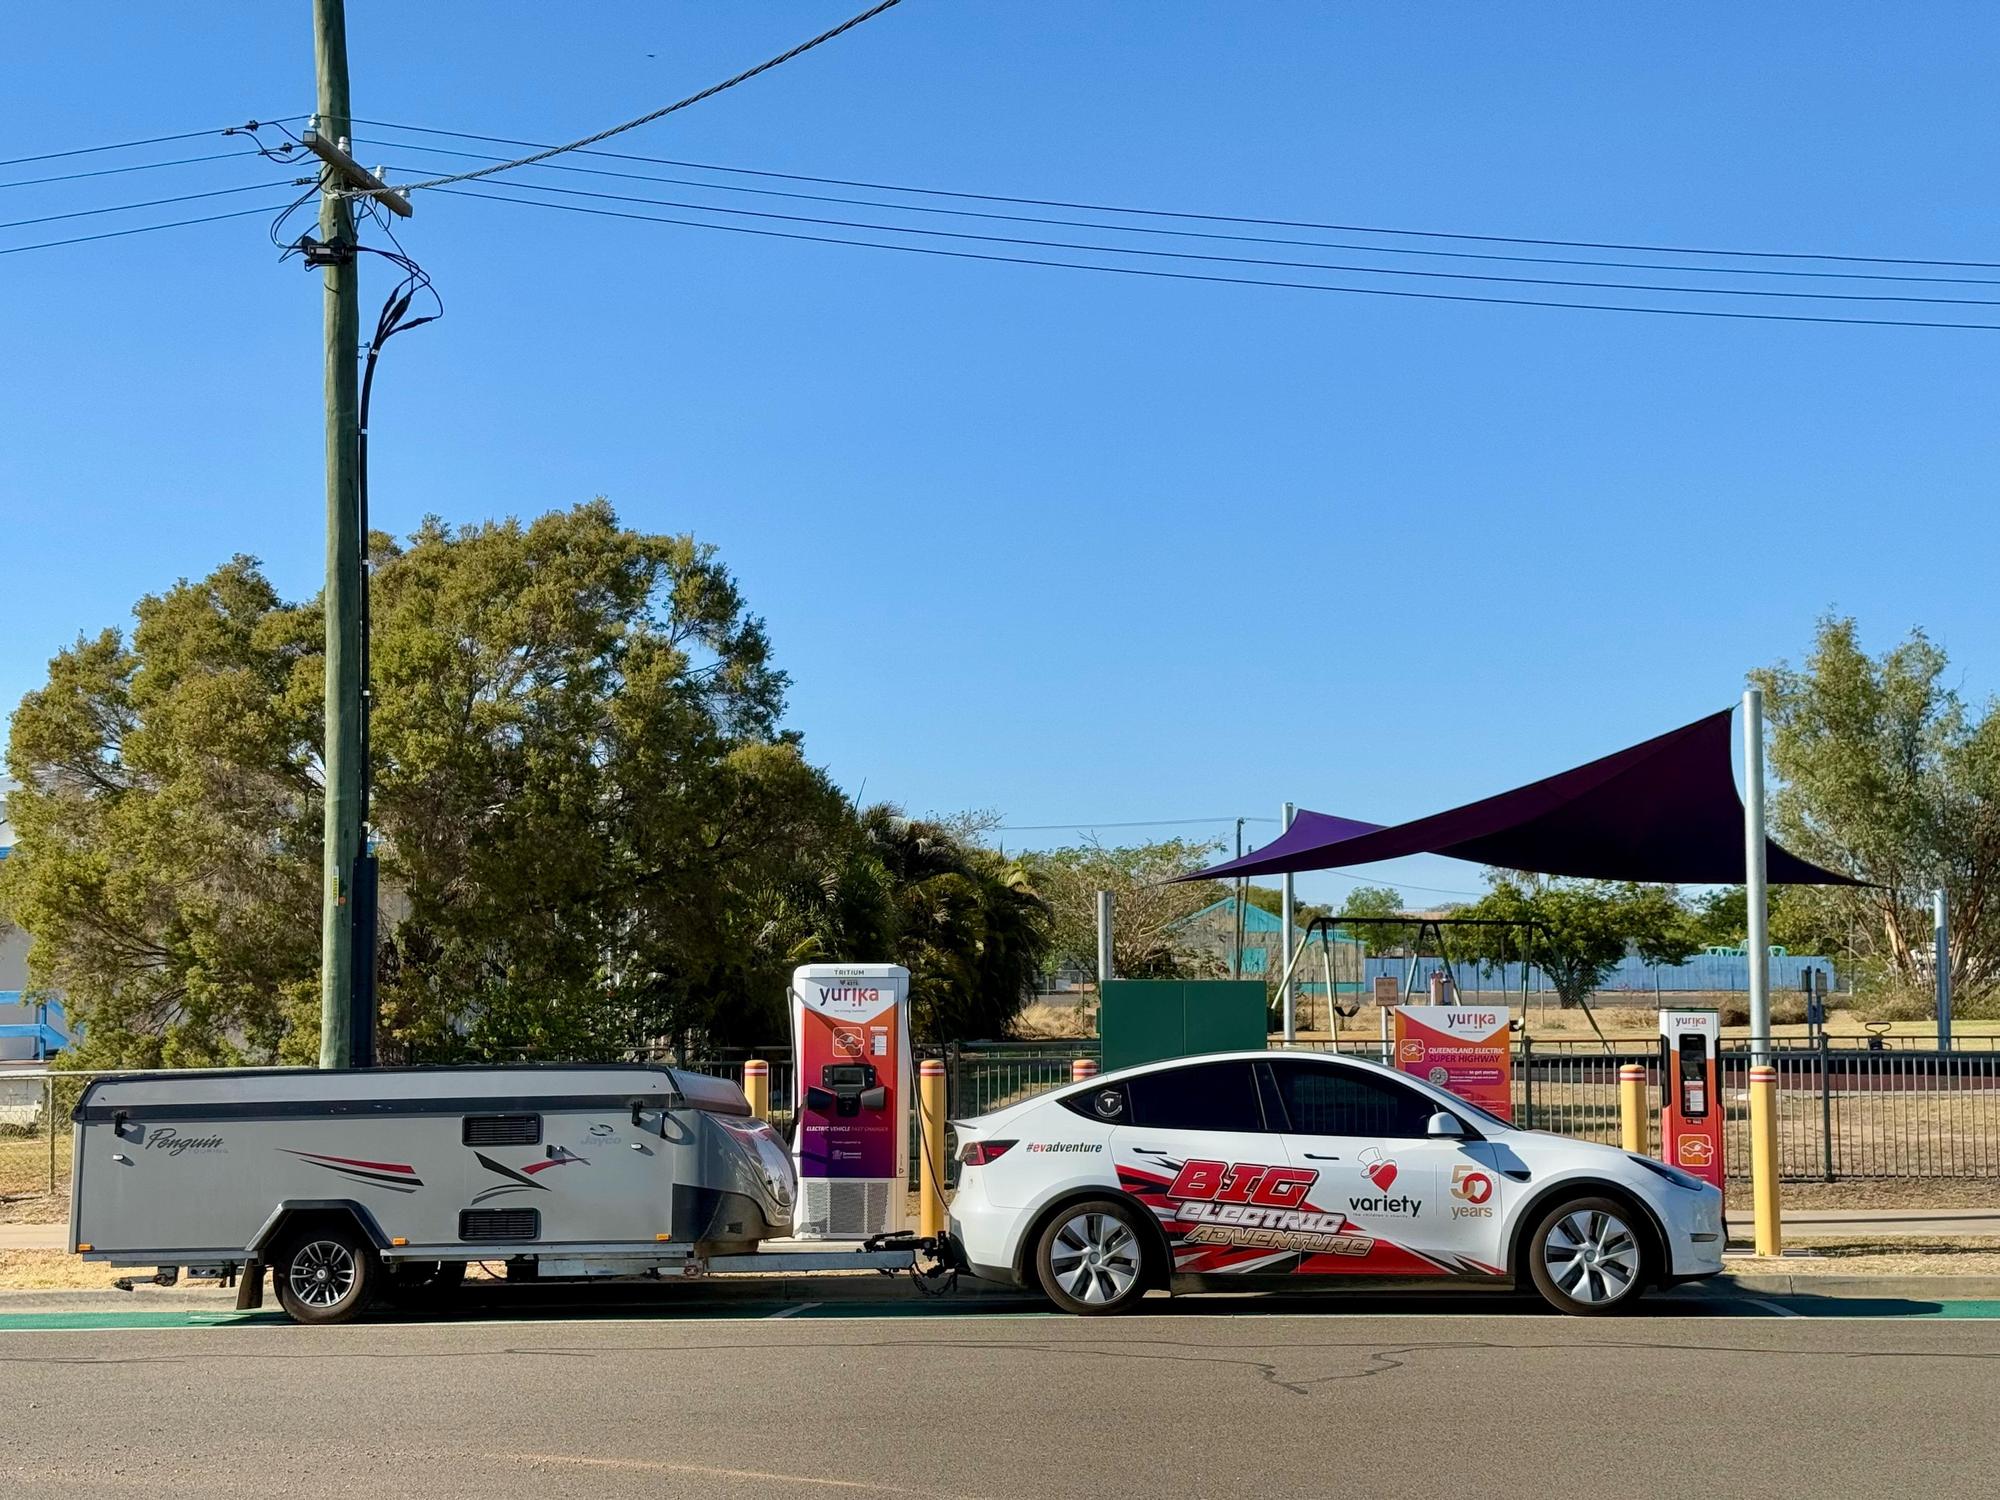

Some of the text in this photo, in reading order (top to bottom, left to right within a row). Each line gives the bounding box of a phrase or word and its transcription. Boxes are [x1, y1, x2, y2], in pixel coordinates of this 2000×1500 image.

[819, 987, 879, 1007] yurika
[1447, 1013, 1496, 1029] yurika
[1675, 1016, 1707, 1027] yurika
[1428, 1055, 1500, 1063] SUPER HIGHWAY
[1474, 1047, 1505, 1055] ELECTRIC
[145, 1128, 224, 1156] Penguin
[1026, 1142, 1103, 1153] #evadventure
[1166, 1159, 1320, 1209] BIG
[1349, 1195, 1422, 1217] variety
[1450, 1206, 1493, 1220] years
[1184, 1224, 1375, 1257] ADVENTURE
